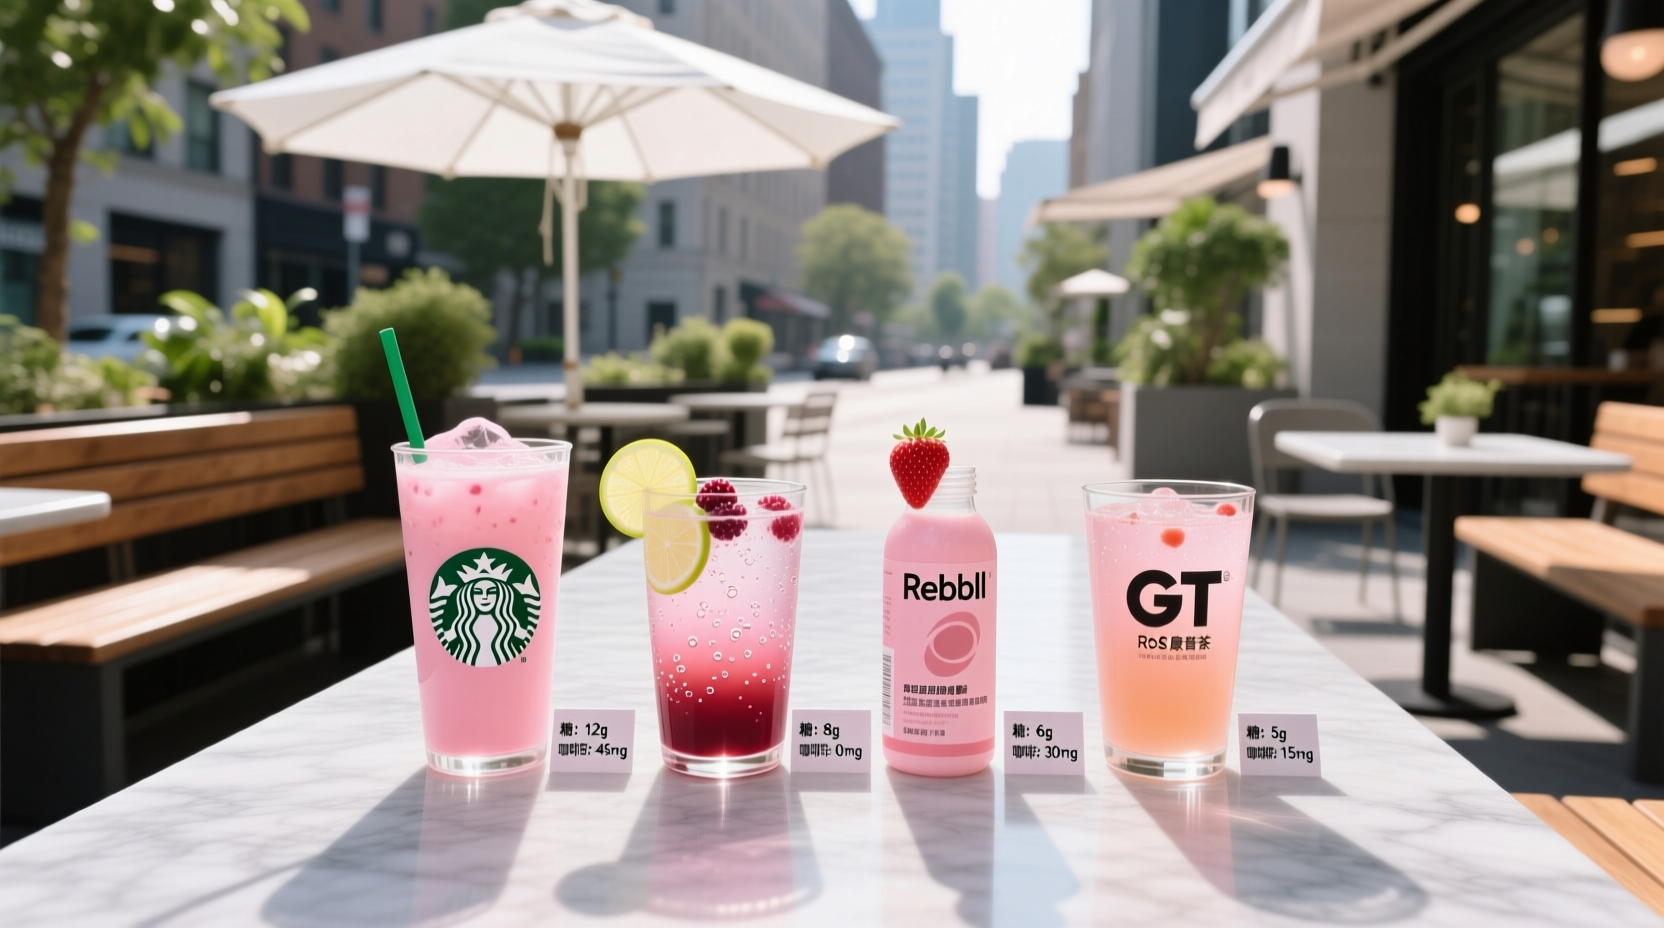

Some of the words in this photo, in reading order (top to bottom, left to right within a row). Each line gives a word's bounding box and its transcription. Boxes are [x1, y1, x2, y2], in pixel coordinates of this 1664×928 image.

[1126, 569, 1222, 628] GT
[585, 722, 608, 740] 12g
[823, 722, 840, 740] 8g
[1036, 724, 1053, 741] 6g
[1271, 726, 1287, 743] 5g
[835, 743, 863, 761] 0mg
